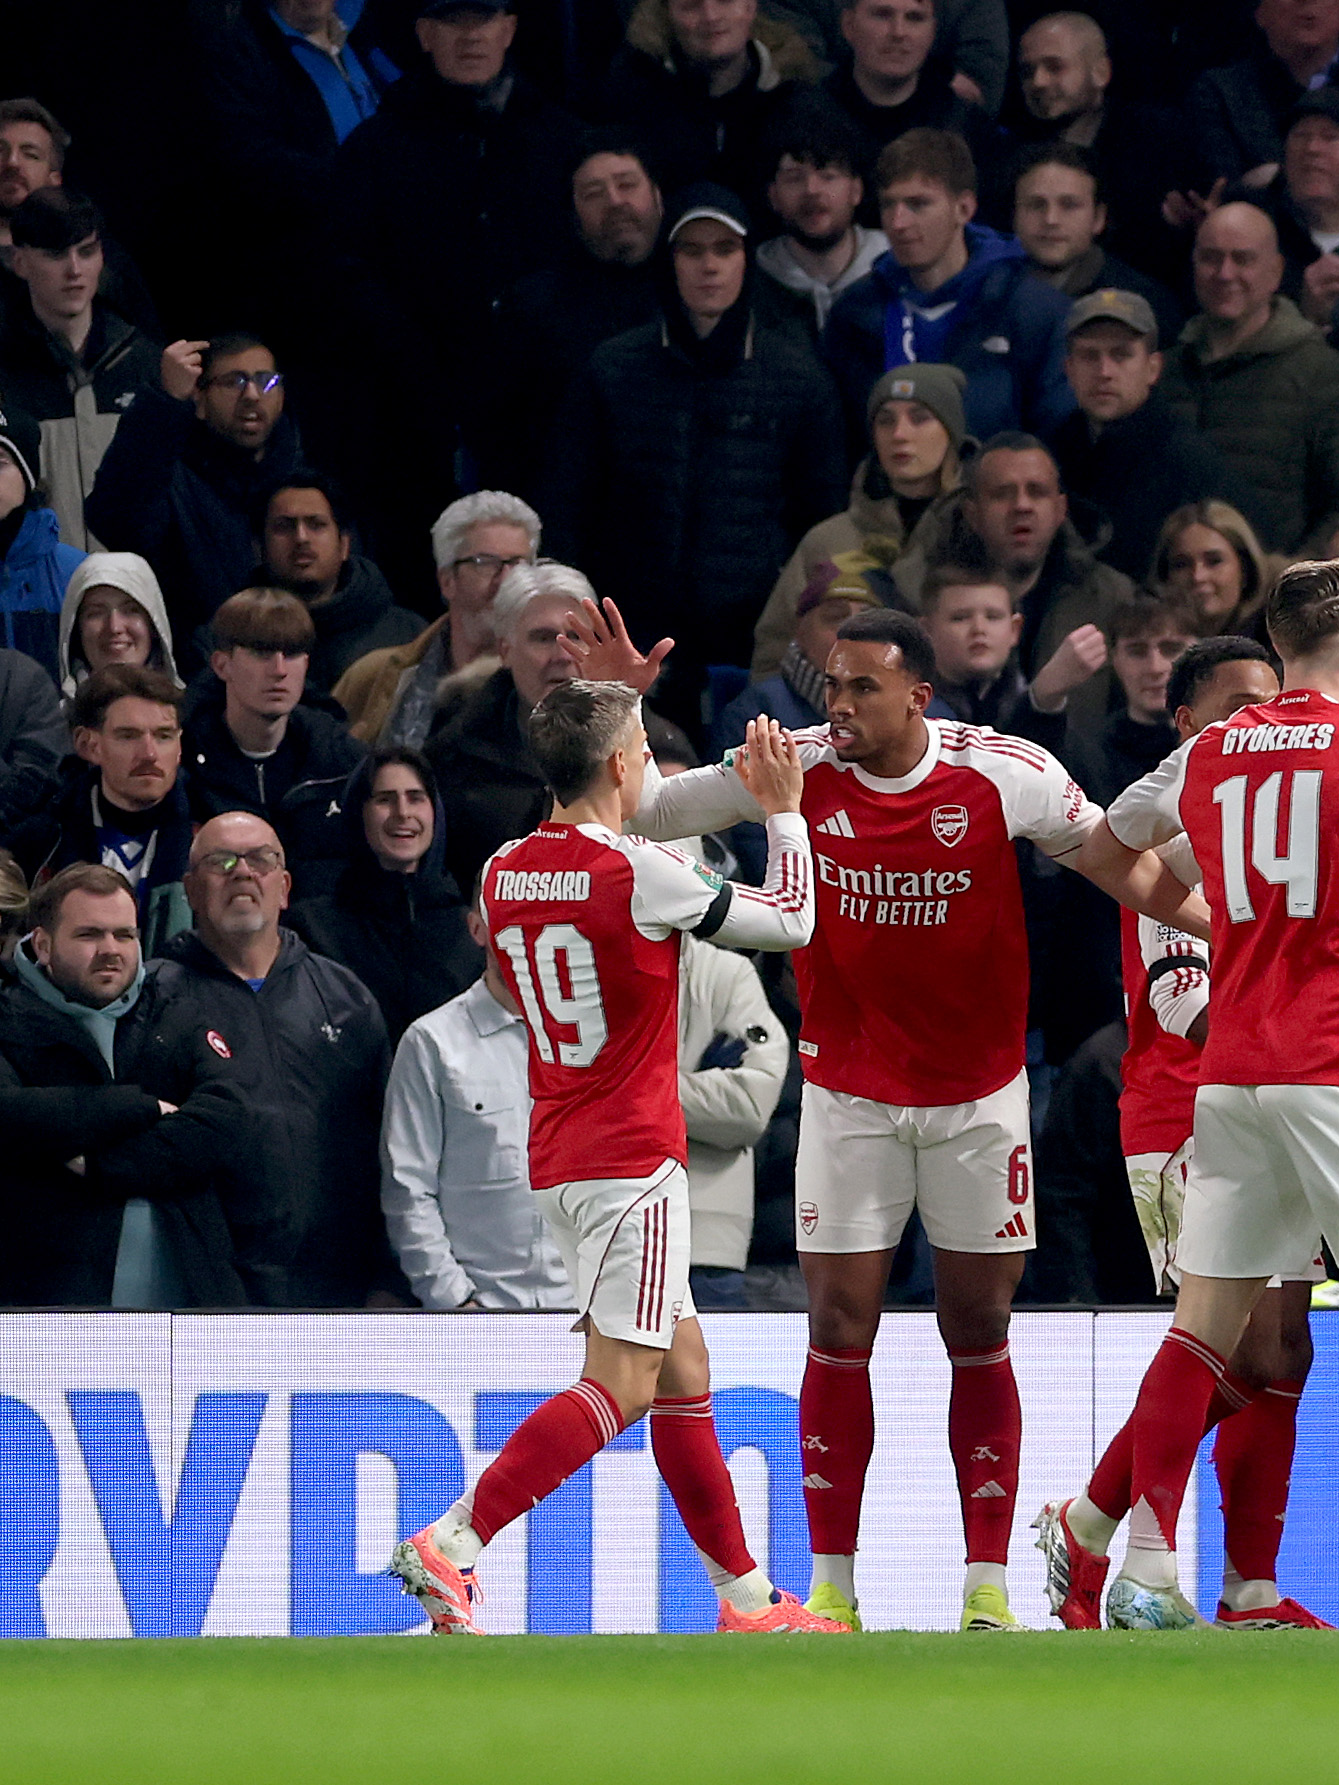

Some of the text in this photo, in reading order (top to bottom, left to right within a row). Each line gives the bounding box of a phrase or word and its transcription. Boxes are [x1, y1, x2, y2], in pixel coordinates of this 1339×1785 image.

[815, 852, 972, 897] Emirates
[1212, 770, 1324, 925] 14
[494, 870, 591, 902] TROSSARD
[839, 893, 949, 926] FLY BETTER
[494, 924, 609, 1068] 19
[1007, 1143, 1030, 1206] 6
